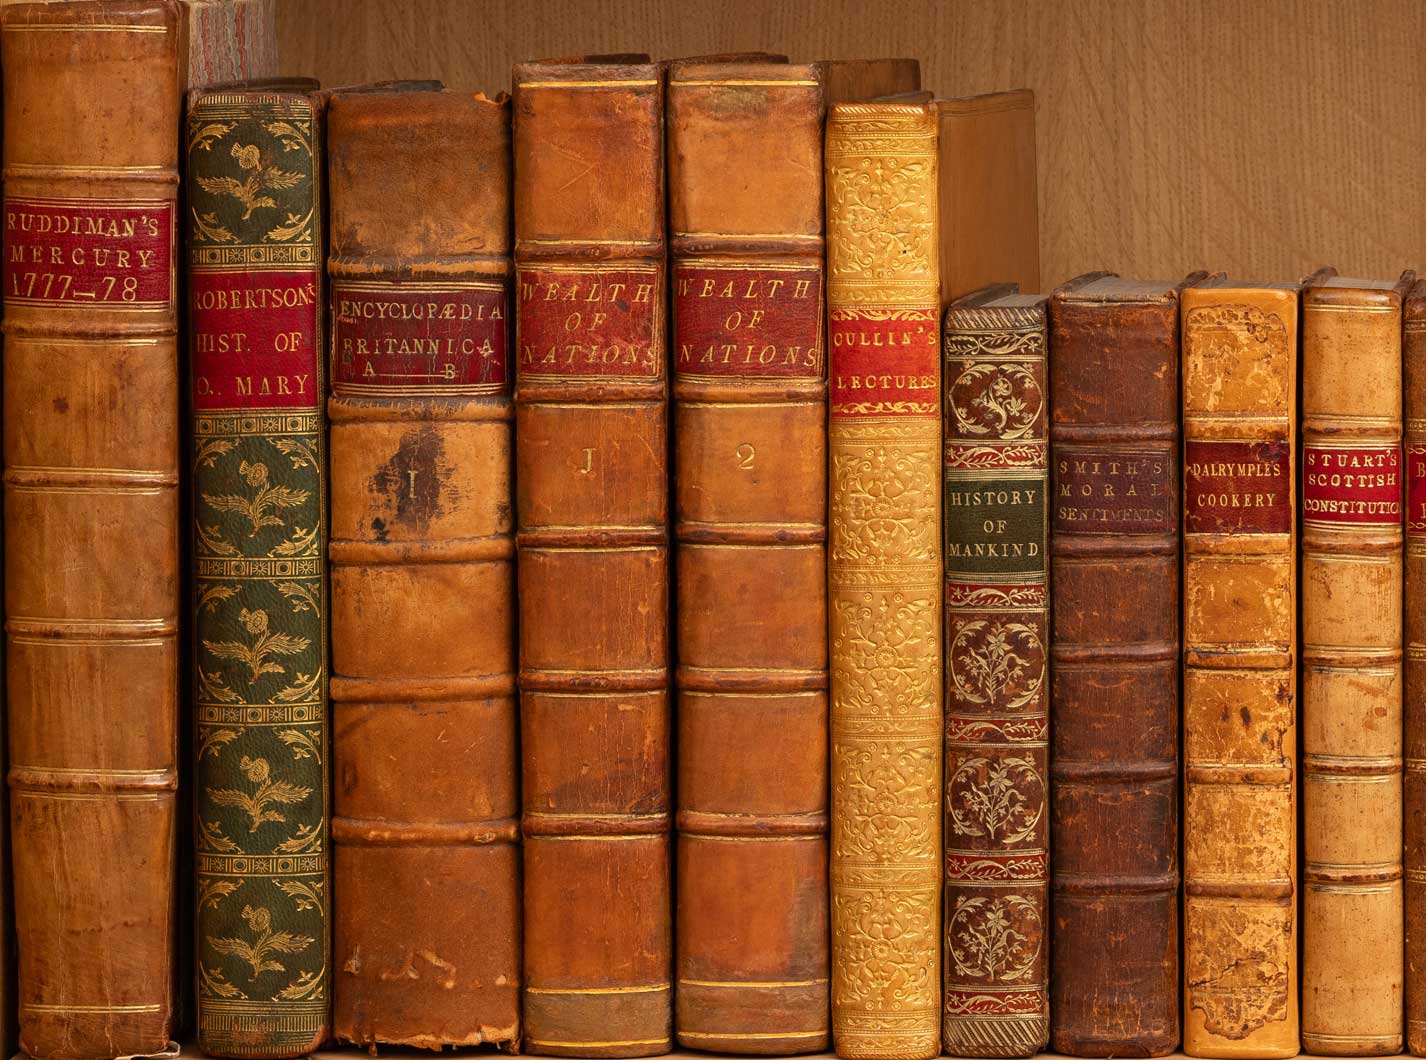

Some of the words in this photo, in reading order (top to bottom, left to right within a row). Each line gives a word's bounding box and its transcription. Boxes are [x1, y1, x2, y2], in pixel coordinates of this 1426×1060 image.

[8, 212, 159, 237] RUDDIMAN'S
[10, 245, 153, 269] MERCURY
[523, 282, 654, 303] WEALTH
[678, 279, 812, 299] WEALTH
[565, 312, 607, 331] OF
[725, 310, 765, 330] OF
[196, 332, 251, 353] HIST.
[274, 332, 303, 352] OF
[343, 337, 495, 356] BRITANNICA
[522, 344, 657, 366] NATIONS
[680, 344, 818, 367] NATIONS
[235, 374, 308, 396] MARY
[837, 374, 937, 389] LECTURES
[736, 443, 756, 470] 2
[1308, 449, 1397, 467] STUART'S
[1059, 459, 1162, 475] SMITH'S
[1308, 473, 1397, 488] SCOTTISH
[951, 490, 1036, 506] HISTORY
[1060, 483, 1161, 498] MORAL
[1197, 494, 1276, 507] COOKERY
[1059, 506, 1165, 522] SENTIMENTS
[983, 520, 1008, 534] OF
[949, 542, 1039, 557] MANKIND
